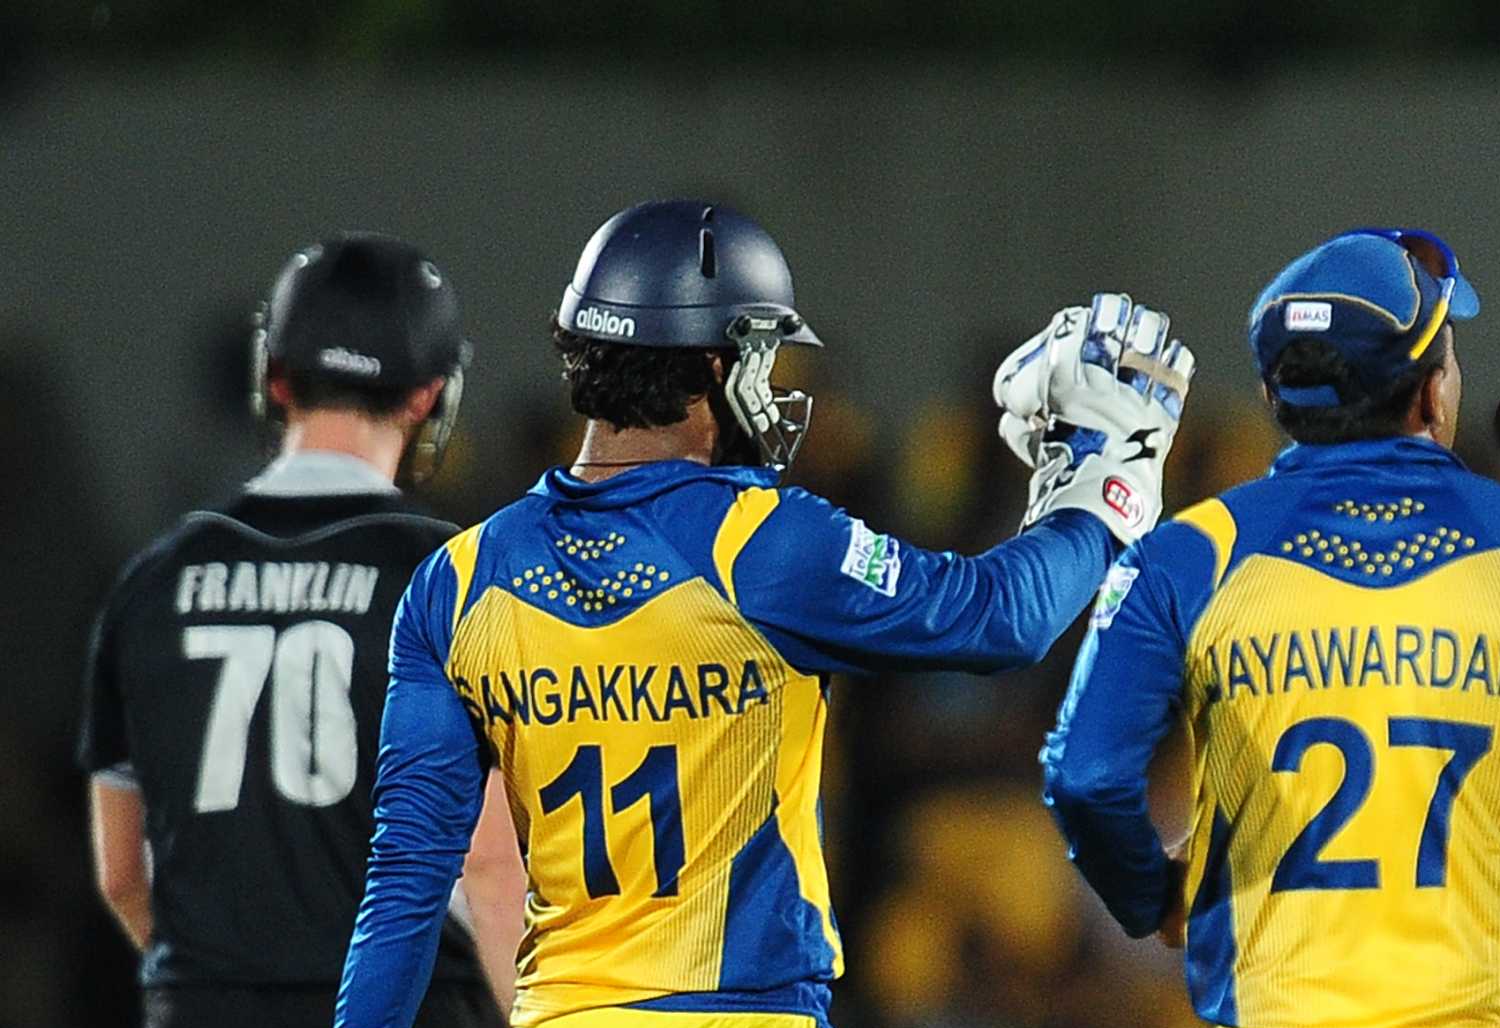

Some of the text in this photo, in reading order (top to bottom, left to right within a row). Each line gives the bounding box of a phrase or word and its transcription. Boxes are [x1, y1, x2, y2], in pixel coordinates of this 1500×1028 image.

[576, 307, 636, 338] albion
[176, 561, 380, 615] FRANKLIN
[183, 619, 359, 814] 70
[538, 744, 686, 901] 11
[1271, 716, 1495, 896] 27
